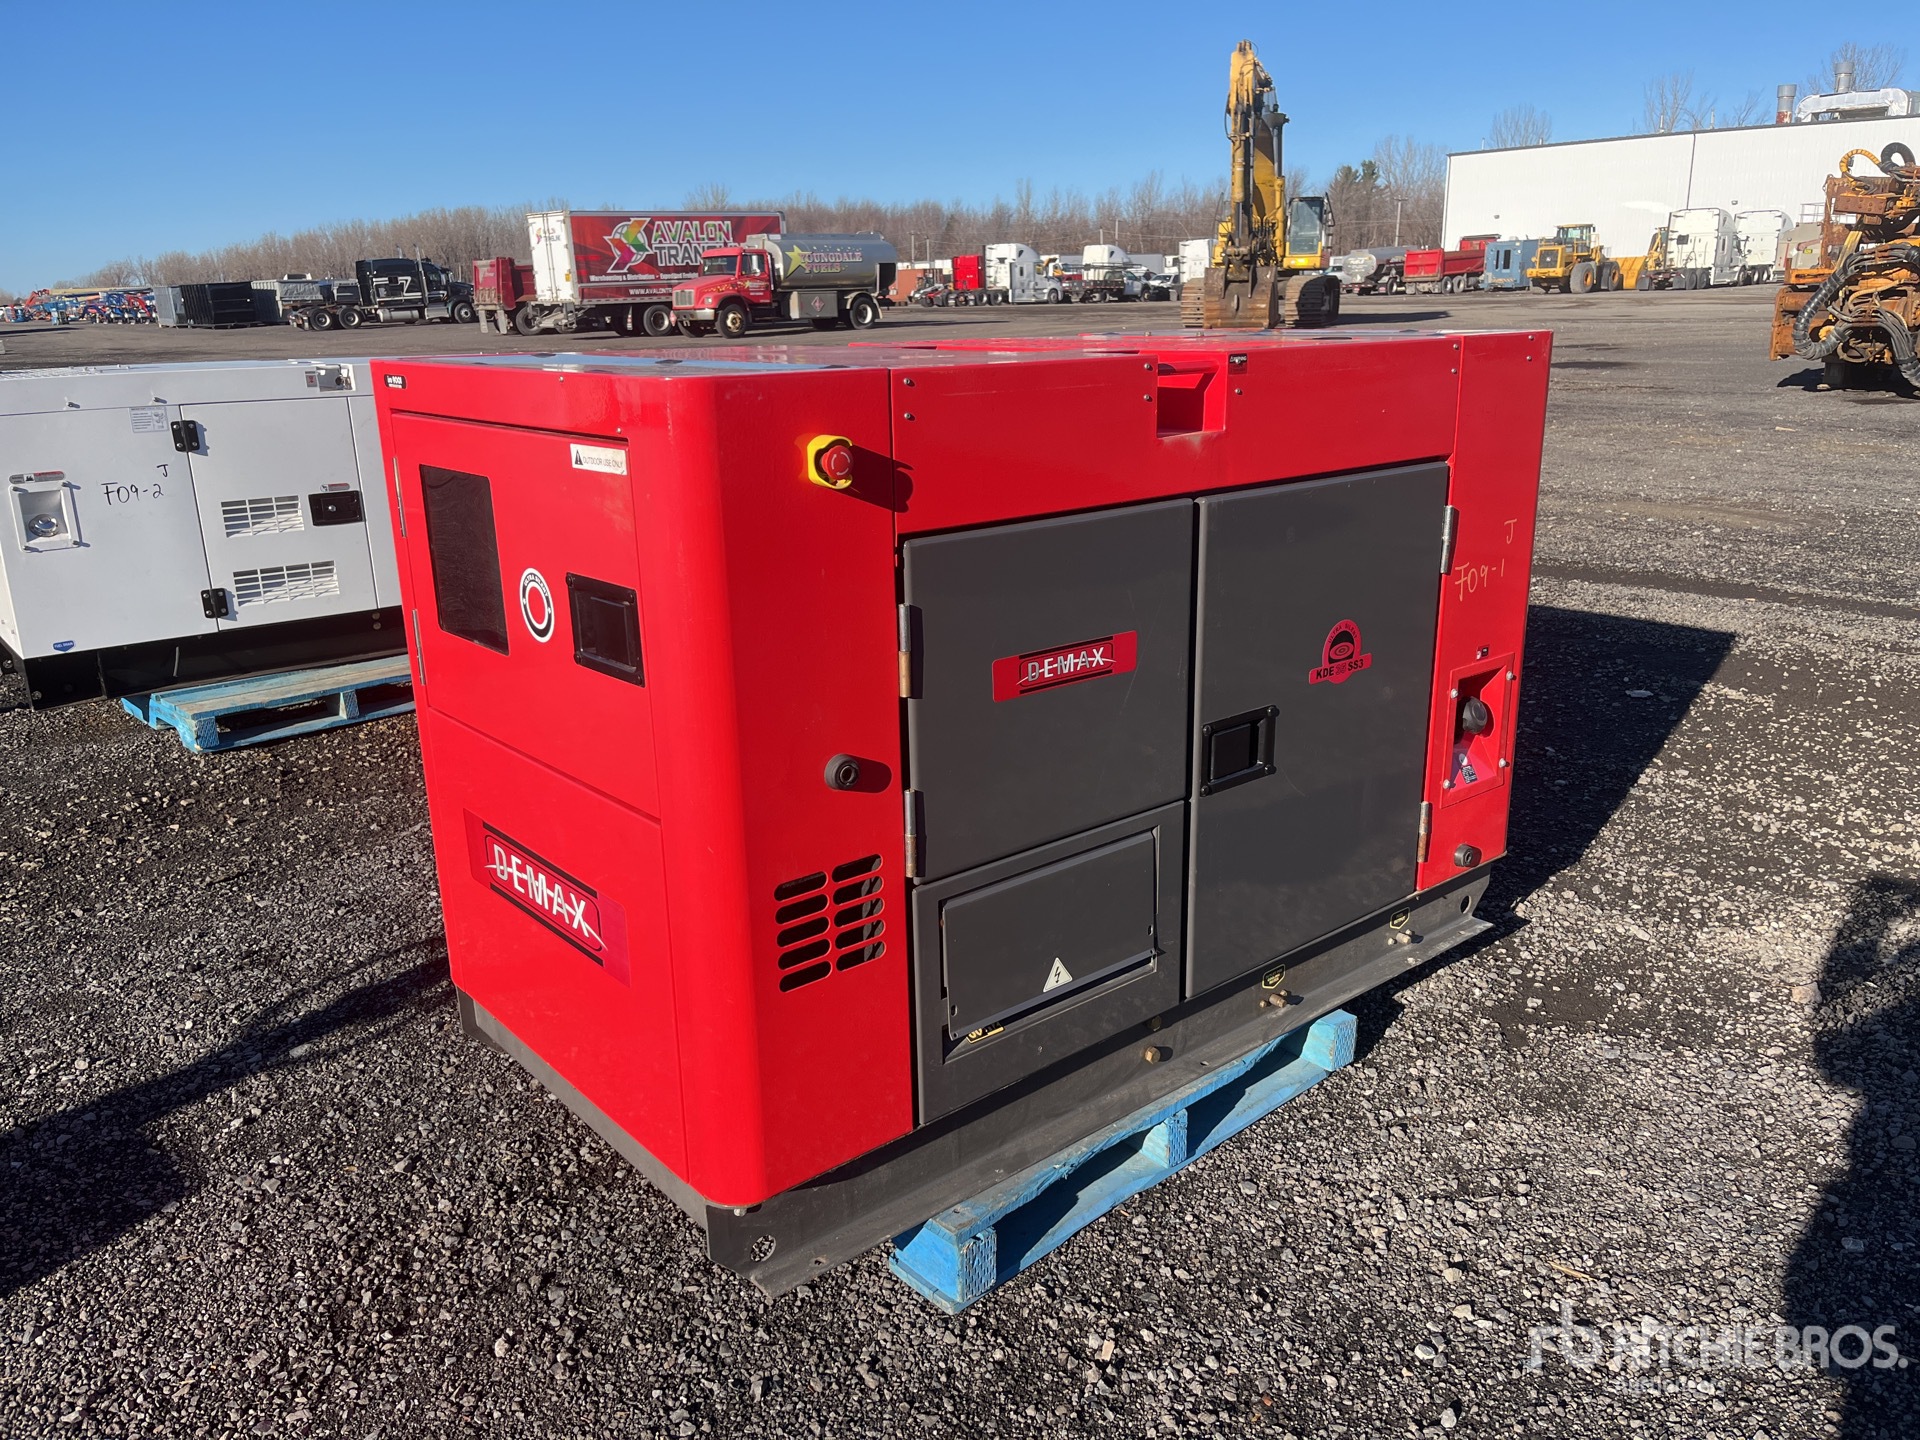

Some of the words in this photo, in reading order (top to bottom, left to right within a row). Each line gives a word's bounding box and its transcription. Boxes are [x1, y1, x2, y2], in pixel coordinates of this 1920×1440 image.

[651, 220, 733, 244] AVALON
[798, 251, 863, 263] YOUNGDALE
[805, 262, 841, 274] FUELS
[100, 481, 164, 506] F09-2
[1027, 646, 1105, 682] DEMAX
[1315, 666, 1335, 680] KDE
[1347, 658, 1364, 672] SS3
[492, 843, 590, 939] DEMAX
